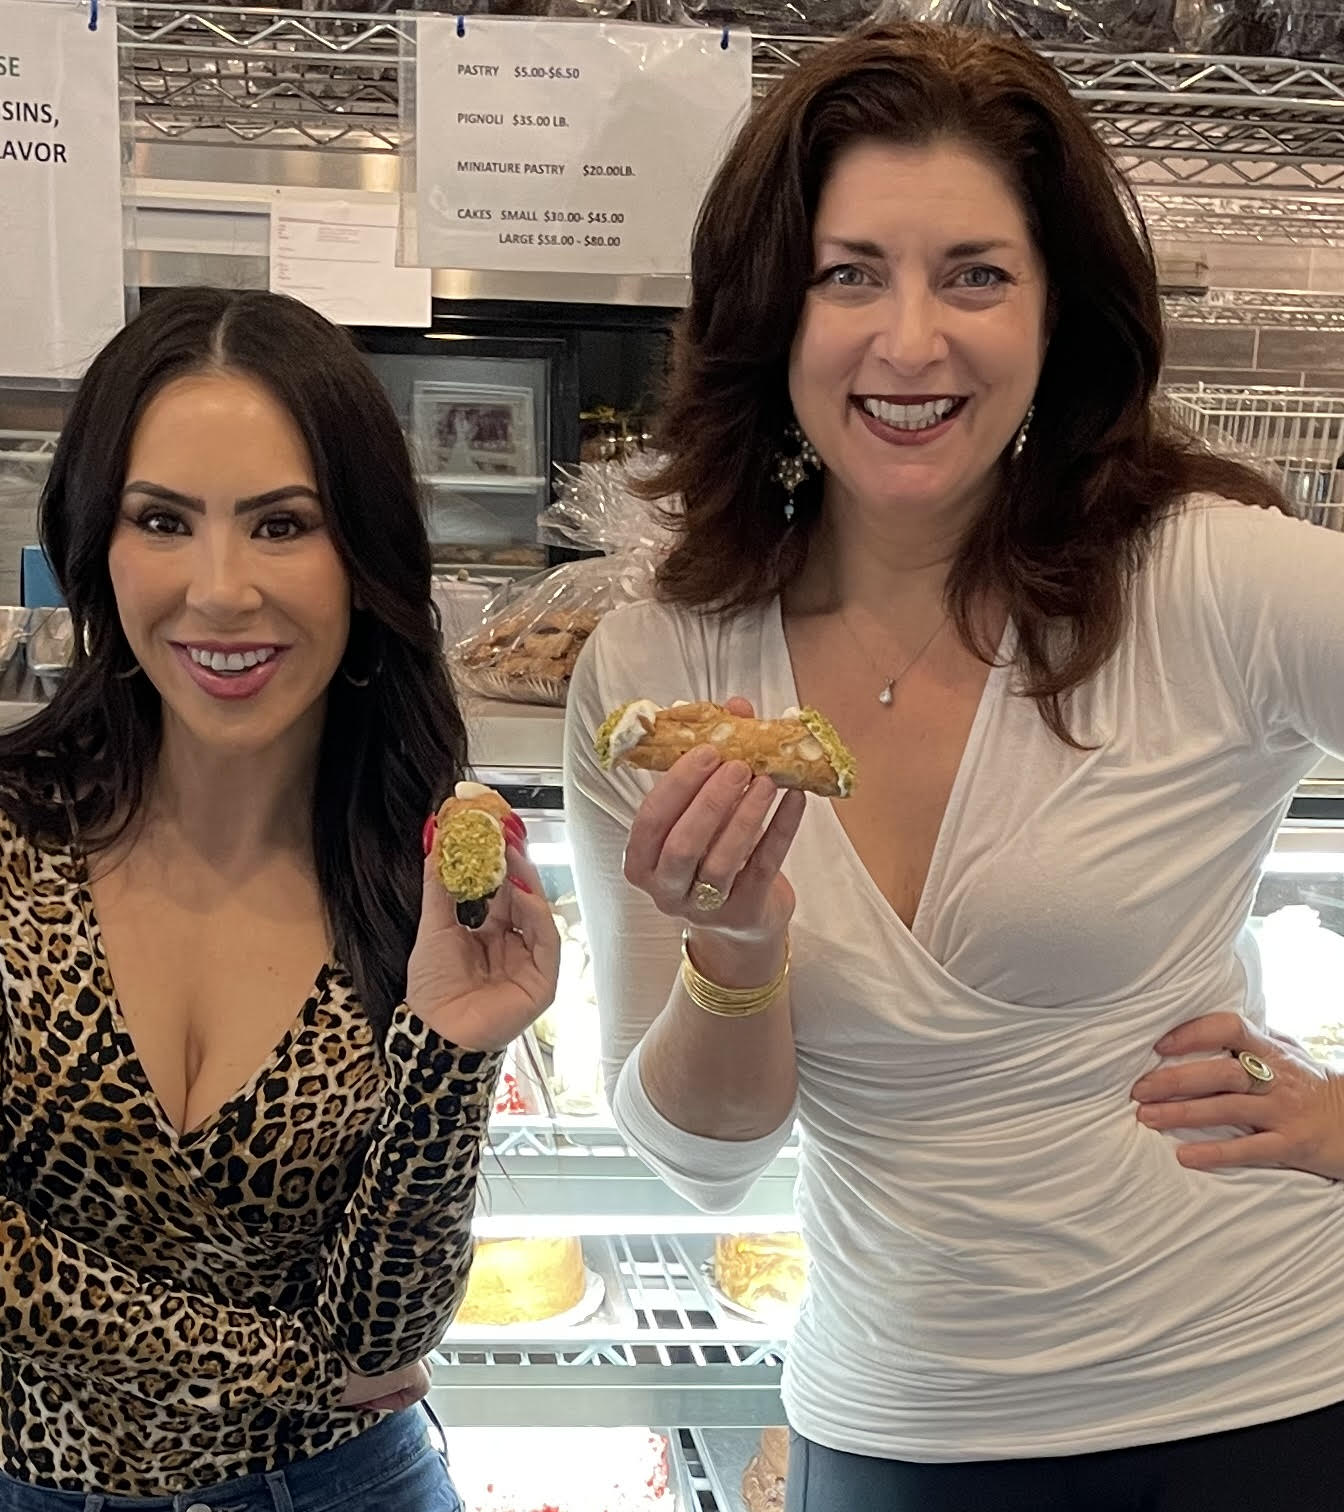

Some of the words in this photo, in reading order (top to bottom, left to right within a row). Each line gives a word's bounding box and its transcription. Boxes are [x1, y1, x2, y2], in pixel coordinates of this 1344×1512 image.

[457, 64, 499, 76] PASTRY
[514, 66, 580, 79] $5.00-$6.50
[457, 113, 503, 125] PIGNOLI
[512, 114, 550, 127] $35.00
[553, 116, 569, 127] LB.
[457, 161, 521, 174] MINIATURE
[524, 164, 565, 175] PASTRY
[457, 209, 492, 220] CAKES
[501, 210, 537, 221] SMALL
[499, 234, 533, 245] LARGE
